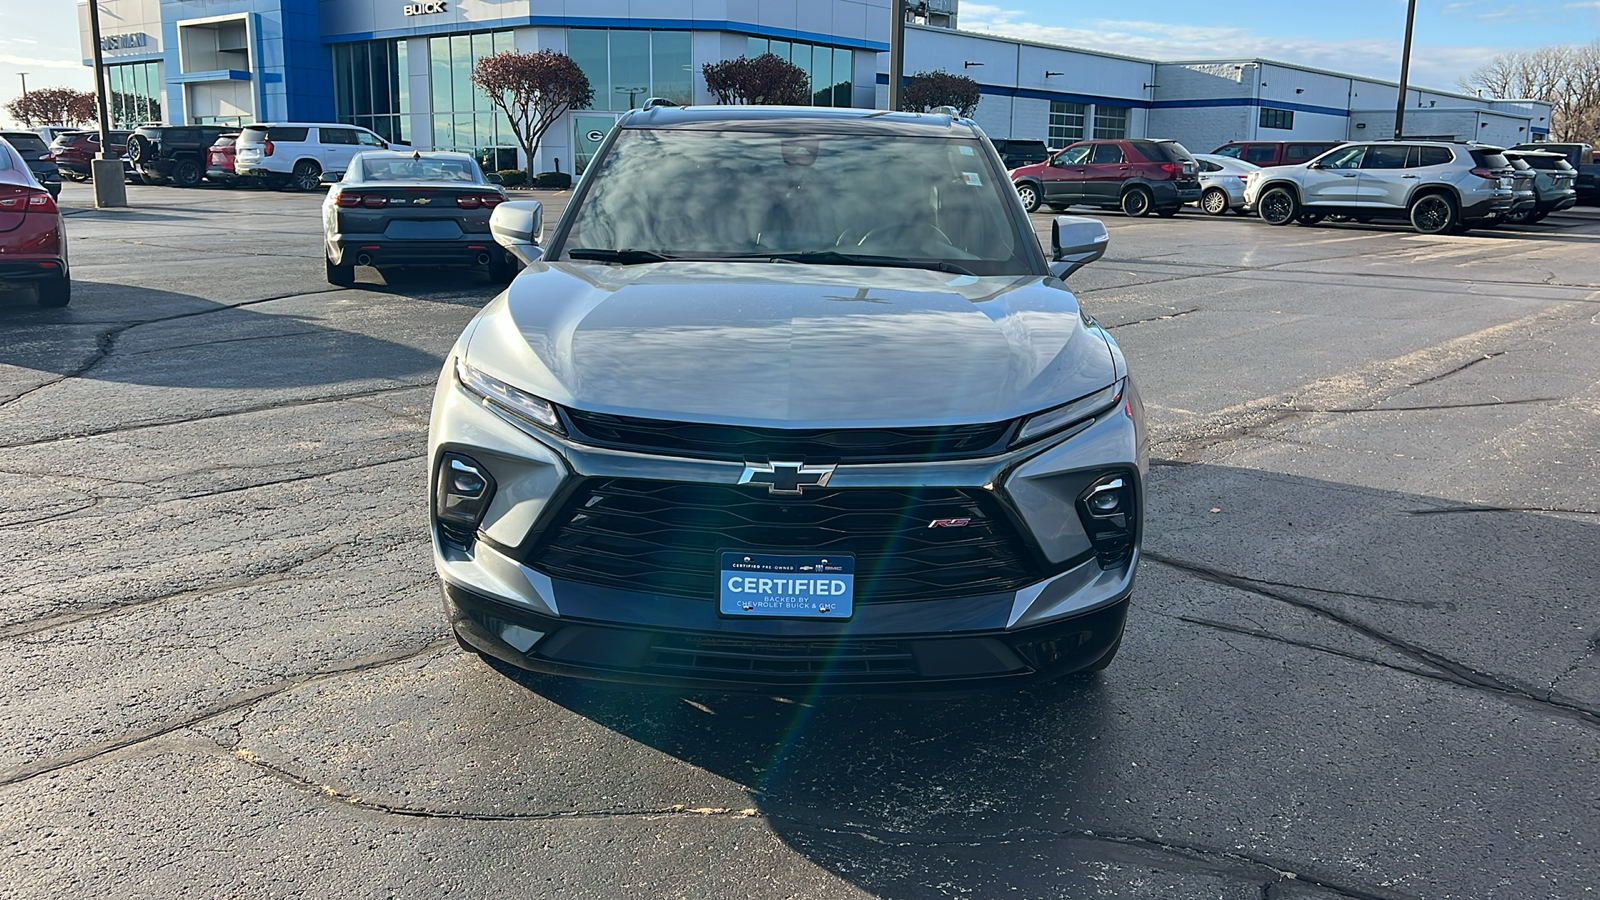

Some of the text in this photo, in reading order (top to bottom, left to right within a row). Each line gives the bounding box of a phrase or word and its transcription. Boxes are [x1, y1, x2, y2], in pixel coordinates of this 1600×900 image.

[403, 2, 445, 16] BUICK
[927, 518, 971, 529] RS
[727, 576, 847, 596] CERTIFIED
[736, 600, 783, 608] CHEVROLET
